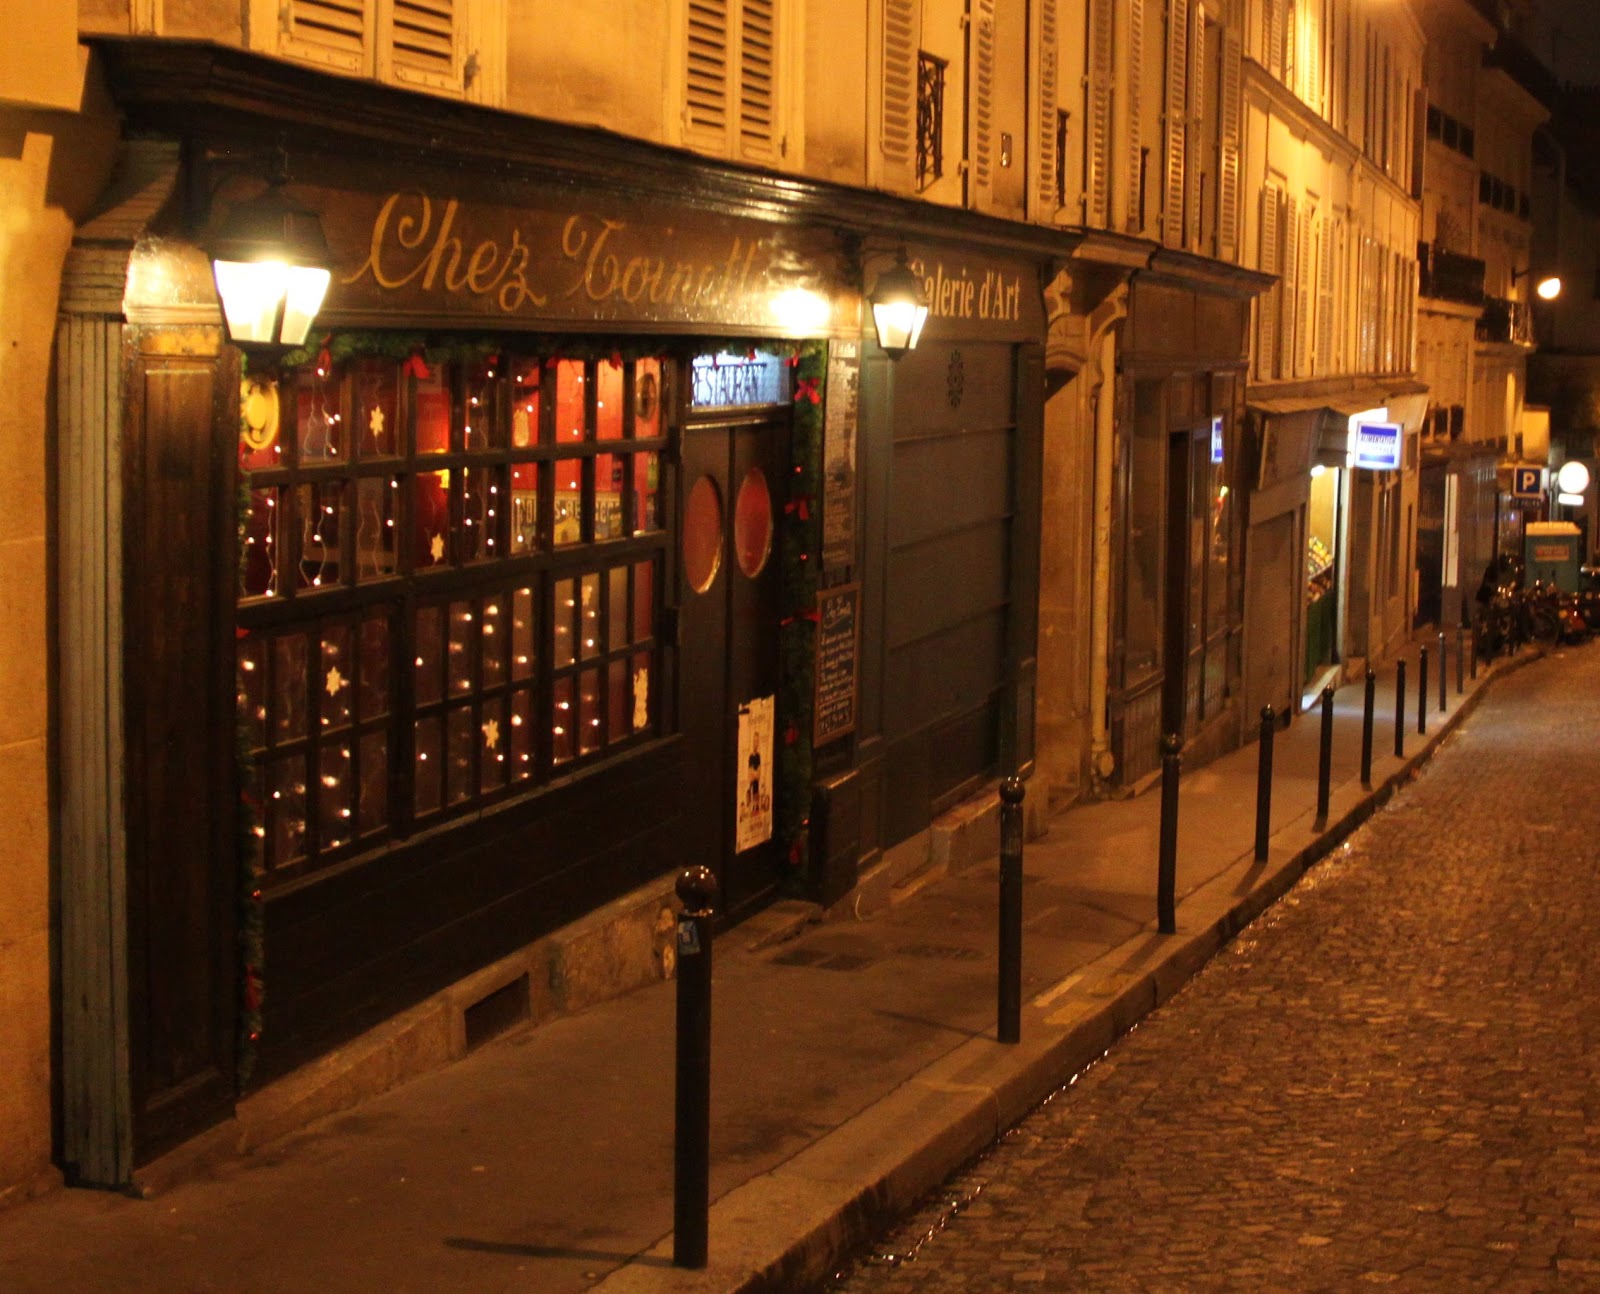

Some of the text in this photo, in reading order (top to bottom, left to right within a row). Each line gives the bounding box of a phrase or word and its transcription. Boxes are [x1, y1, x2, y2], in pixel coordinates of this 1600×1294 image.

[342, 190, 547, 312] Chez
[978, 267, 1021, 322] d'Art
[1523, 471, 1536, 491] P
